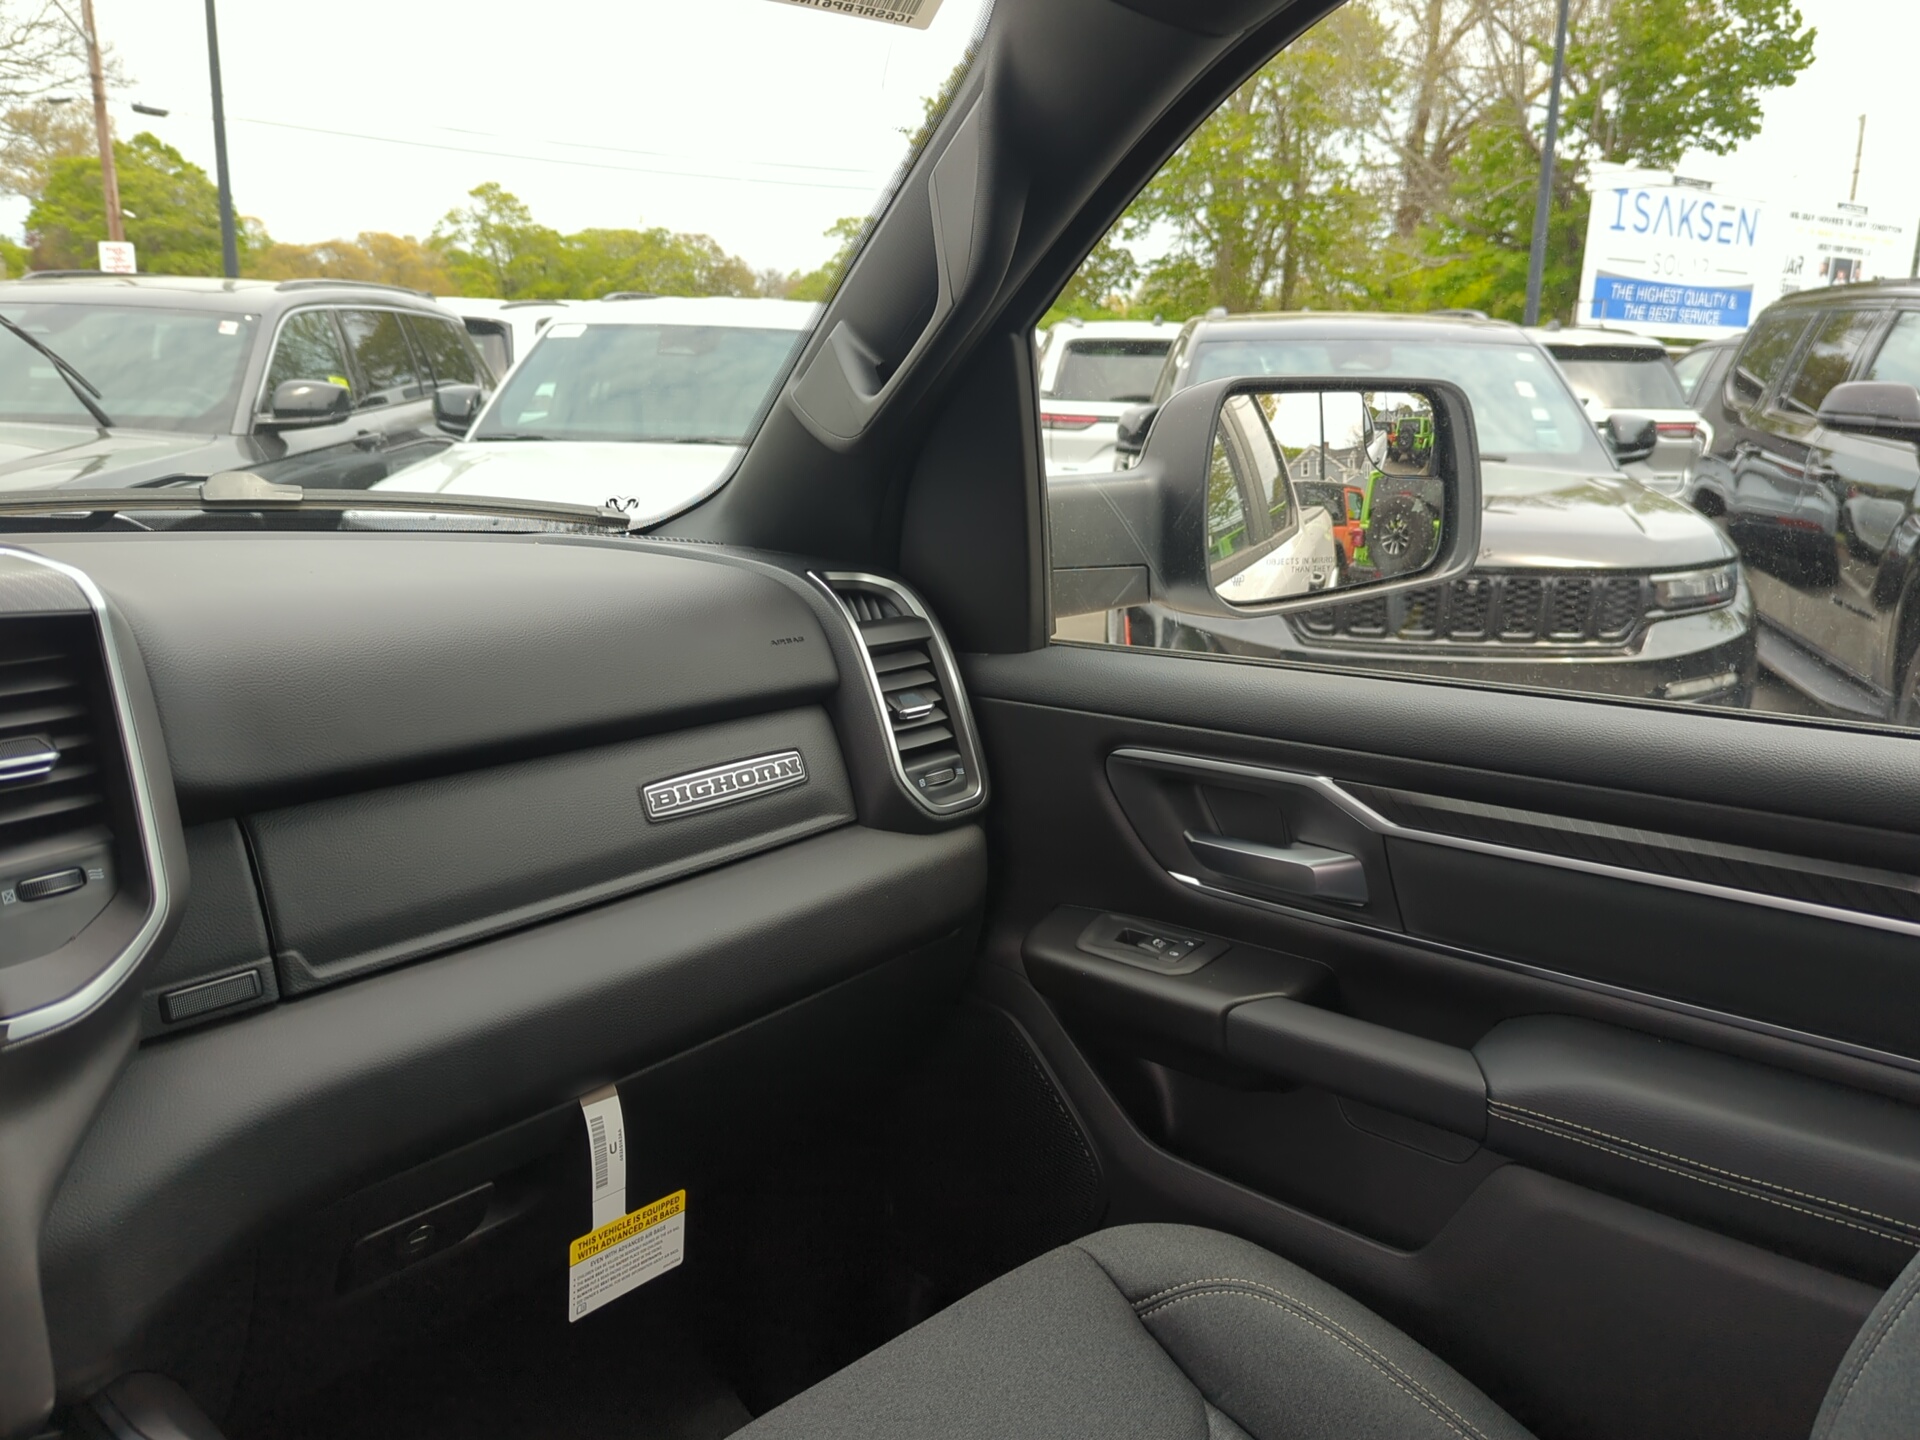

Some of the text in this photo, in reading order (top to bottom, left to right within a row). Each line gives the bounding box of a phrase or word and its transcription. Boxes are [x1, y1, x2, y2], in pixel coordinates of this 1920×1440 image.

[1610, 188, 1761, 247] ISAKSEN
[1611, 283, 1737, 310] THE HIGHEST QUALITY &
[1624, 303, 1722, 325] THE BEST SERVICE
[1266, 557, 1299, 565] OBJECTS
[1312, 556, 1336, 564] MIRRO
[647, 756, 803, 812] BIGHORN
[577, 1204, 680, 1260] WITH ADVANCED AIR BAGS
[578, 1196, 680, 1250] THIS VEHICLE IS EQUIPPED
[590, 1225, 667, 1267] EVEN WITH ADVANCED AIR BAGS
